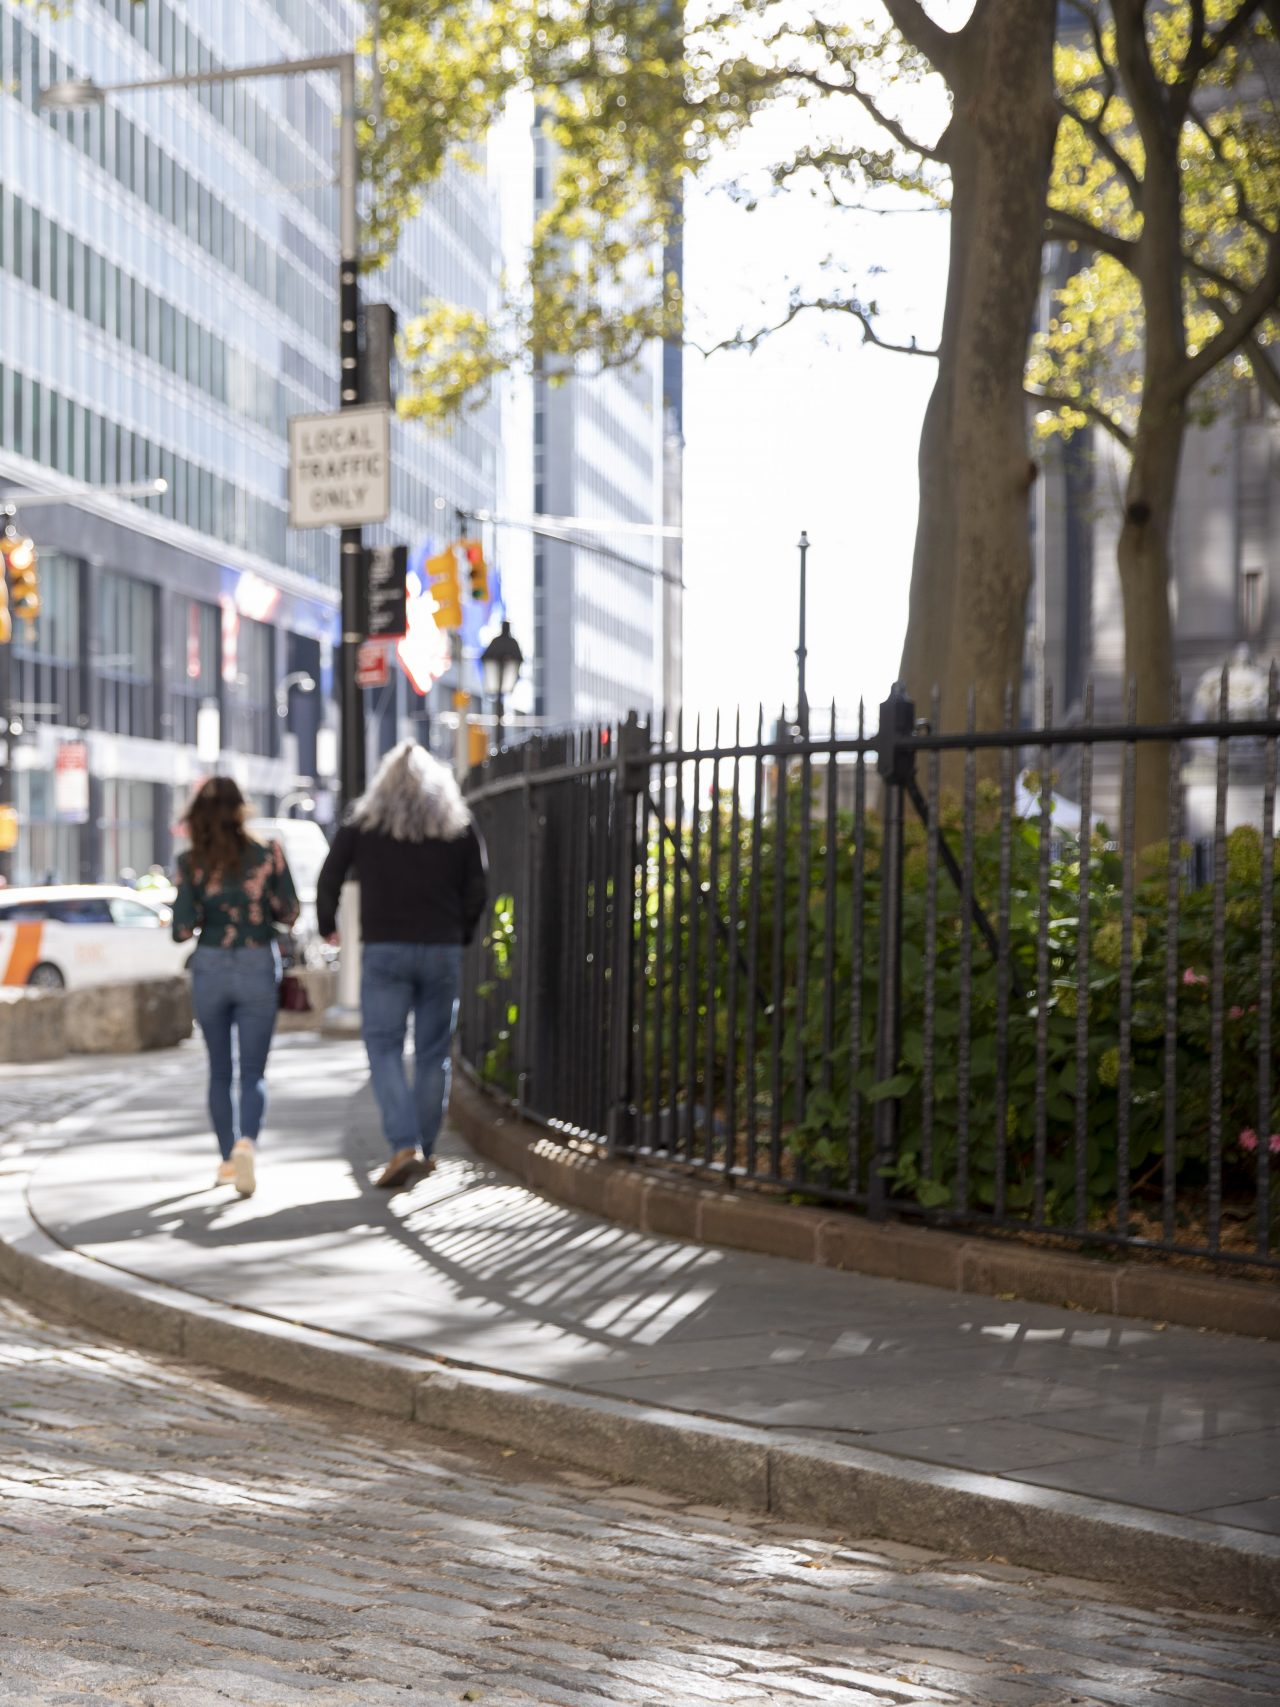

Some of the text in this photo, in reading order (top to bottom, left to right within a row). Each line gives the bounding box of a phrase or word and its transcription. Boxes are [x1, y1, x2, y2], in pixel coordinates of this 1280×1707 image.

[301, 424, 376, 456] LOCAL
[298, 452, 384, 483] TRAFFIC
[309, 483, 369, 512] ONLY
